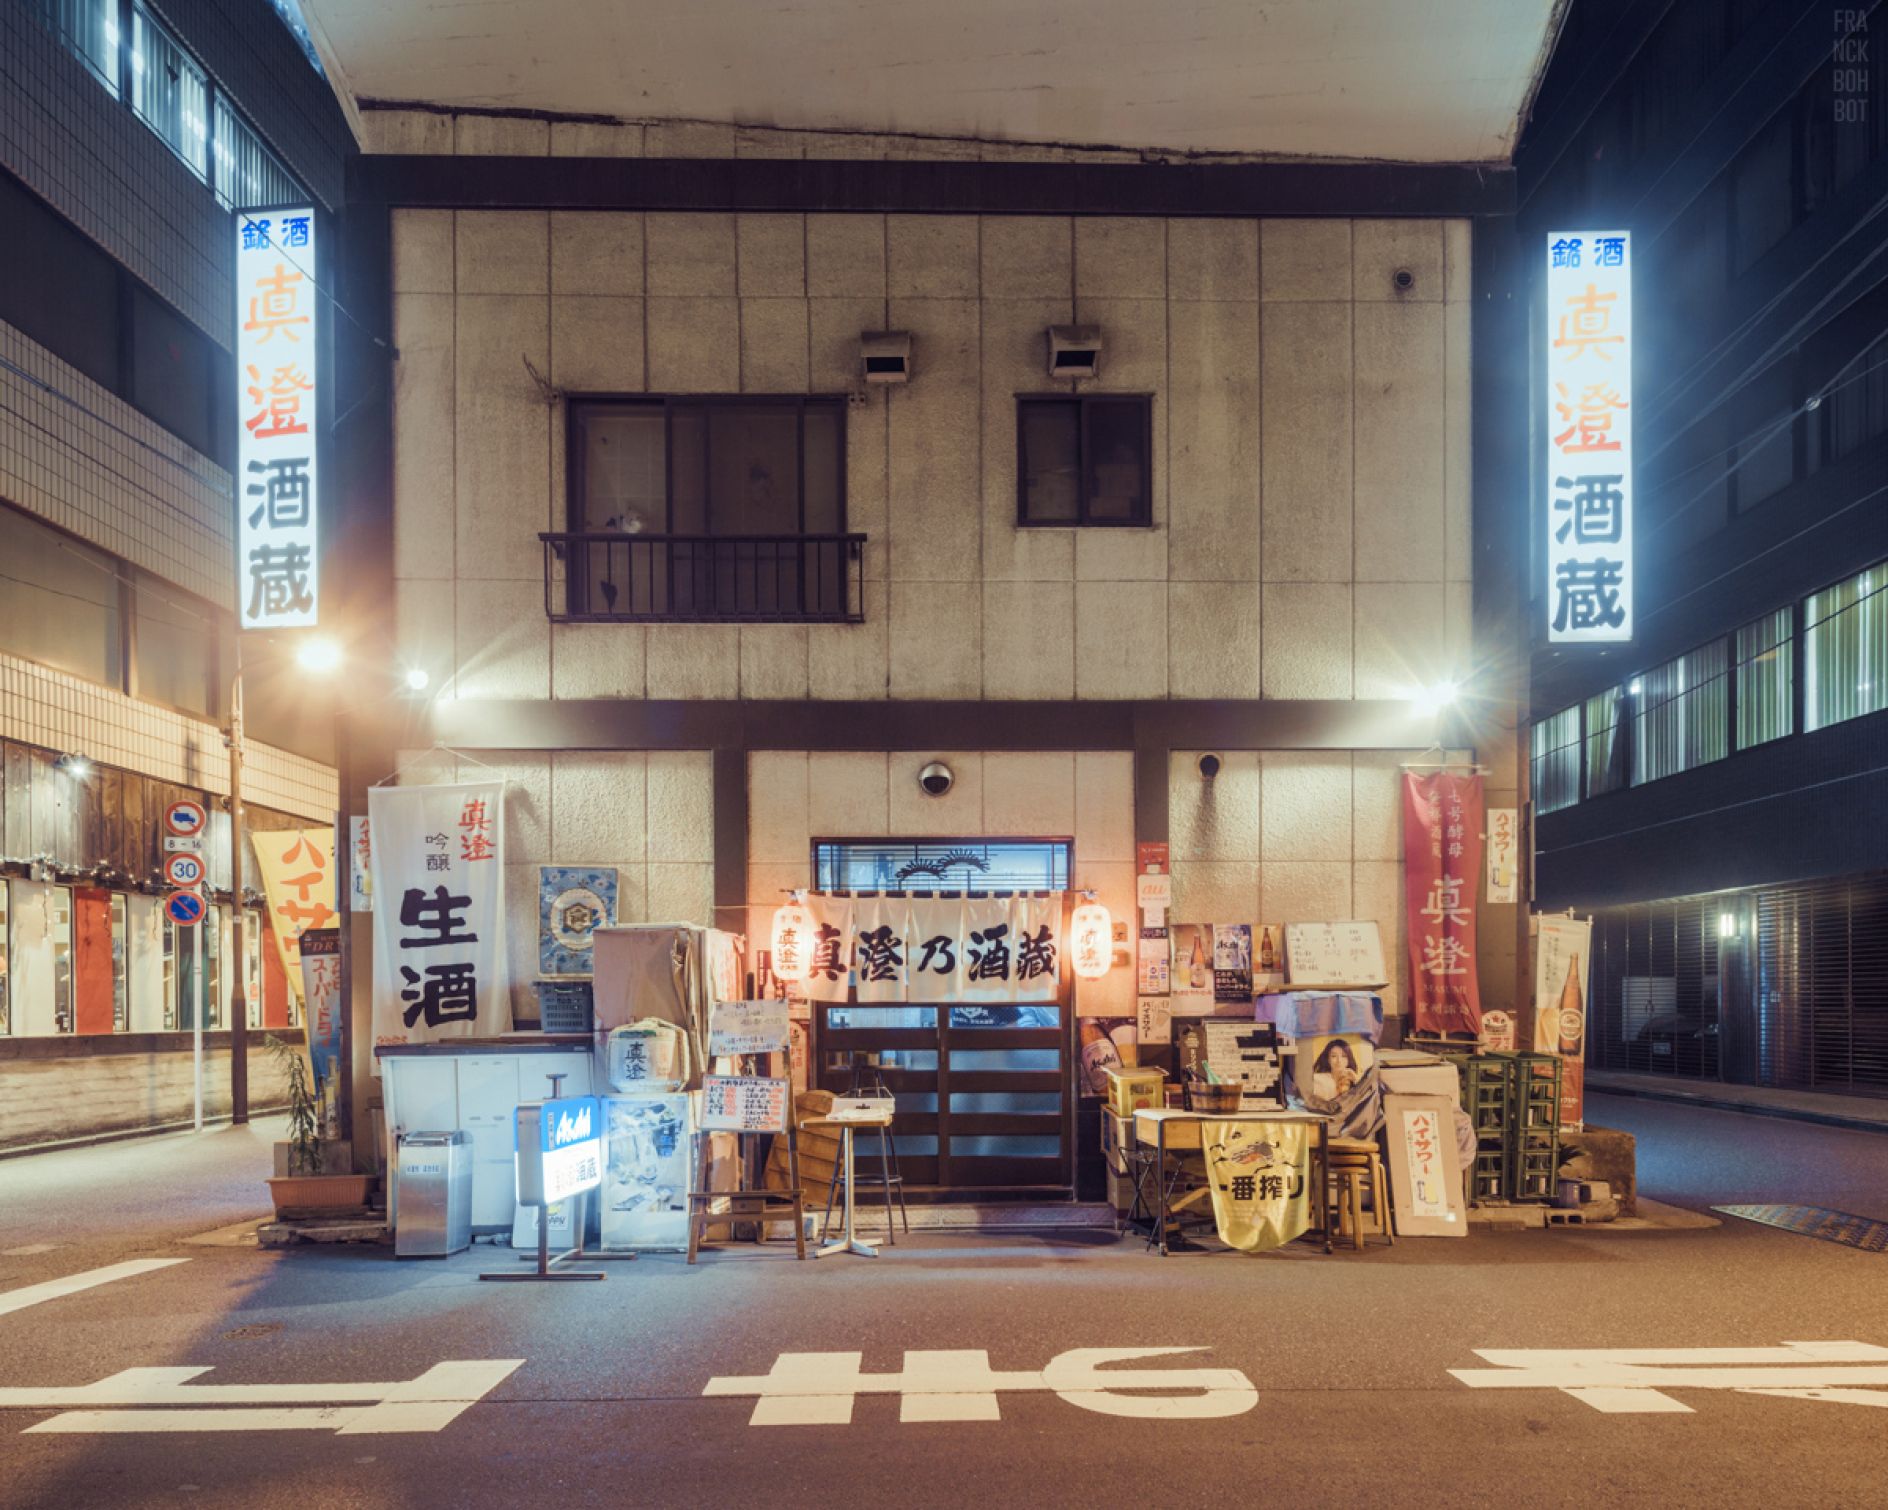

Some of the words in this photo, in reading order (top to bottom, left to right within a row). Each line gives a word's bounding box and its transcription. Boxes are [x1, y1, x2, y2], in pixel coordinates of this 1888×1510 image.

[241, 216, 311, 250] 銘酒
[1550, 237, 1626, 269] 銘酒
[457, 799, 497, 862] 真澄
[173, 861, 198, 879] 30
[1420, 872, 1472, 976] 真澄
[400, 885, 479, 1028] 生酒
[625, 1040, 648, 1080] 真澄
[555, 1105, 592, 1146] Asahi
[1412, 1114, 1433, 1175] ハイサワー
[1219, 1174, 1304, 1201] 一番搾り
